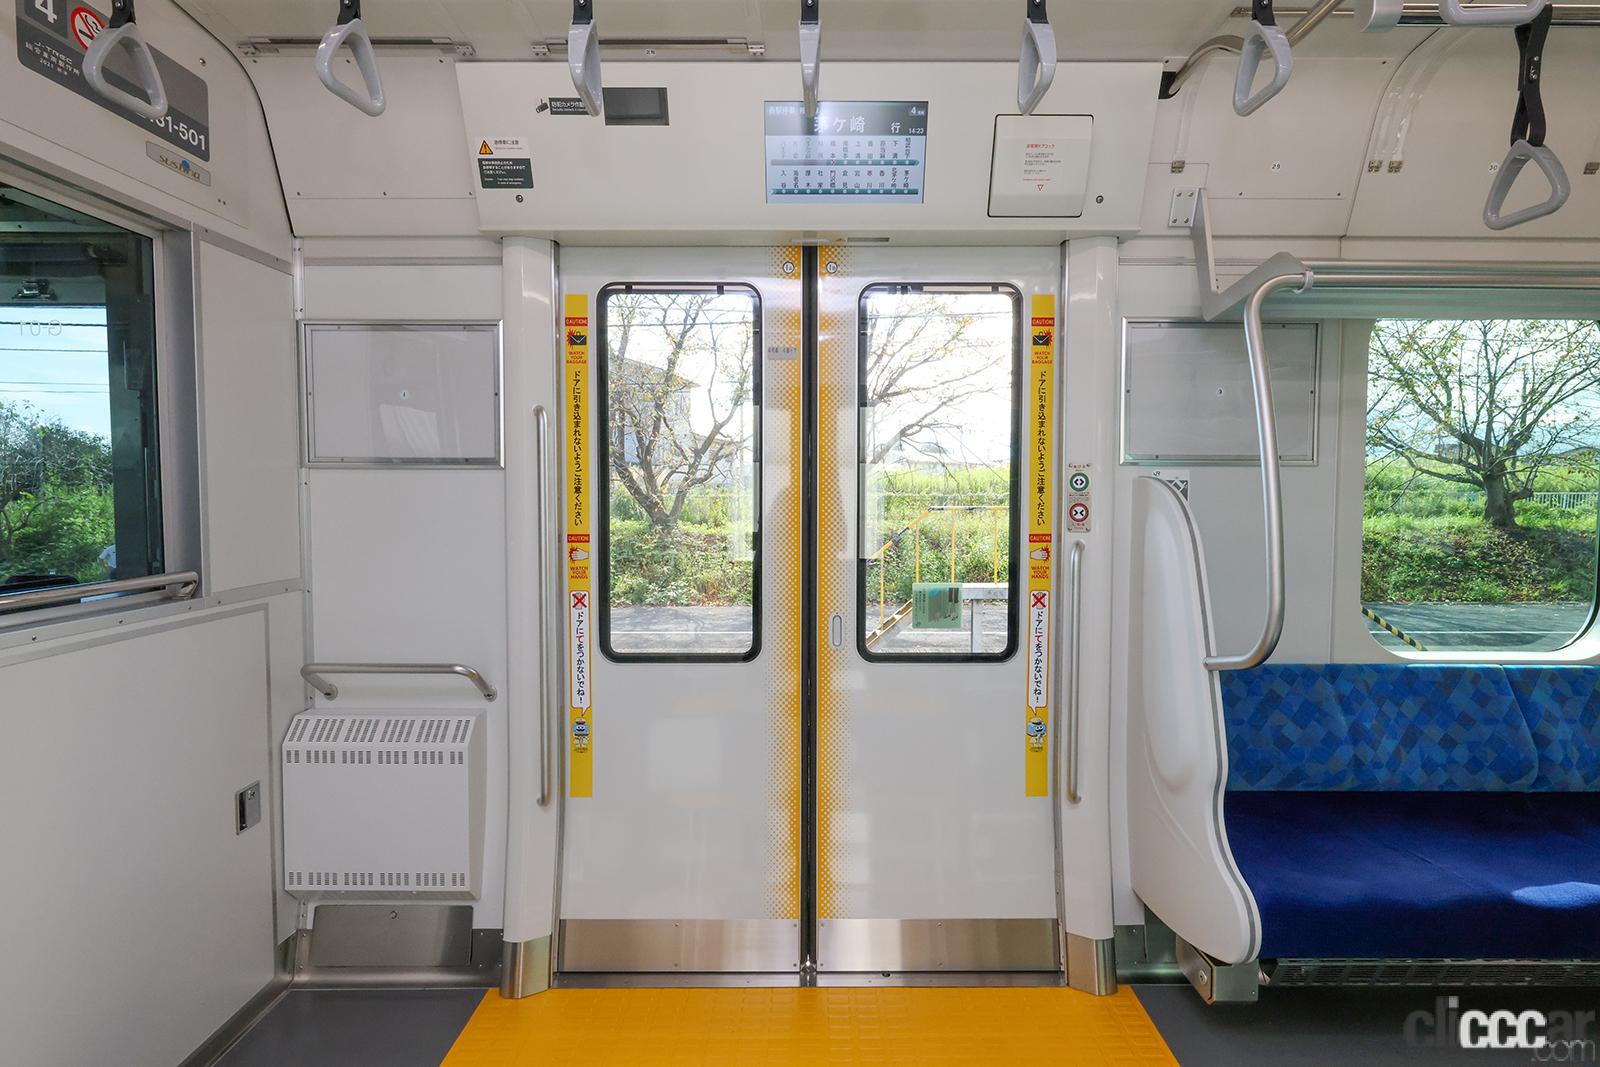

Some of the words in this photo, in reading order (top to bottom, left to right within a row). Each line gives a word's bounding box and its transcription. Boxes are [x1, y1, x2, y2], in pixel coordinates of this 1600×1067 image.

[35, 0, 57, 24] 4
[890, 121, 900, 133] 行
[572, 370, 583, 526] ドアに引き込まれないようご注意ください
[1037, 370, 1046, 526] ドアに引き込まれないようご注意ください
